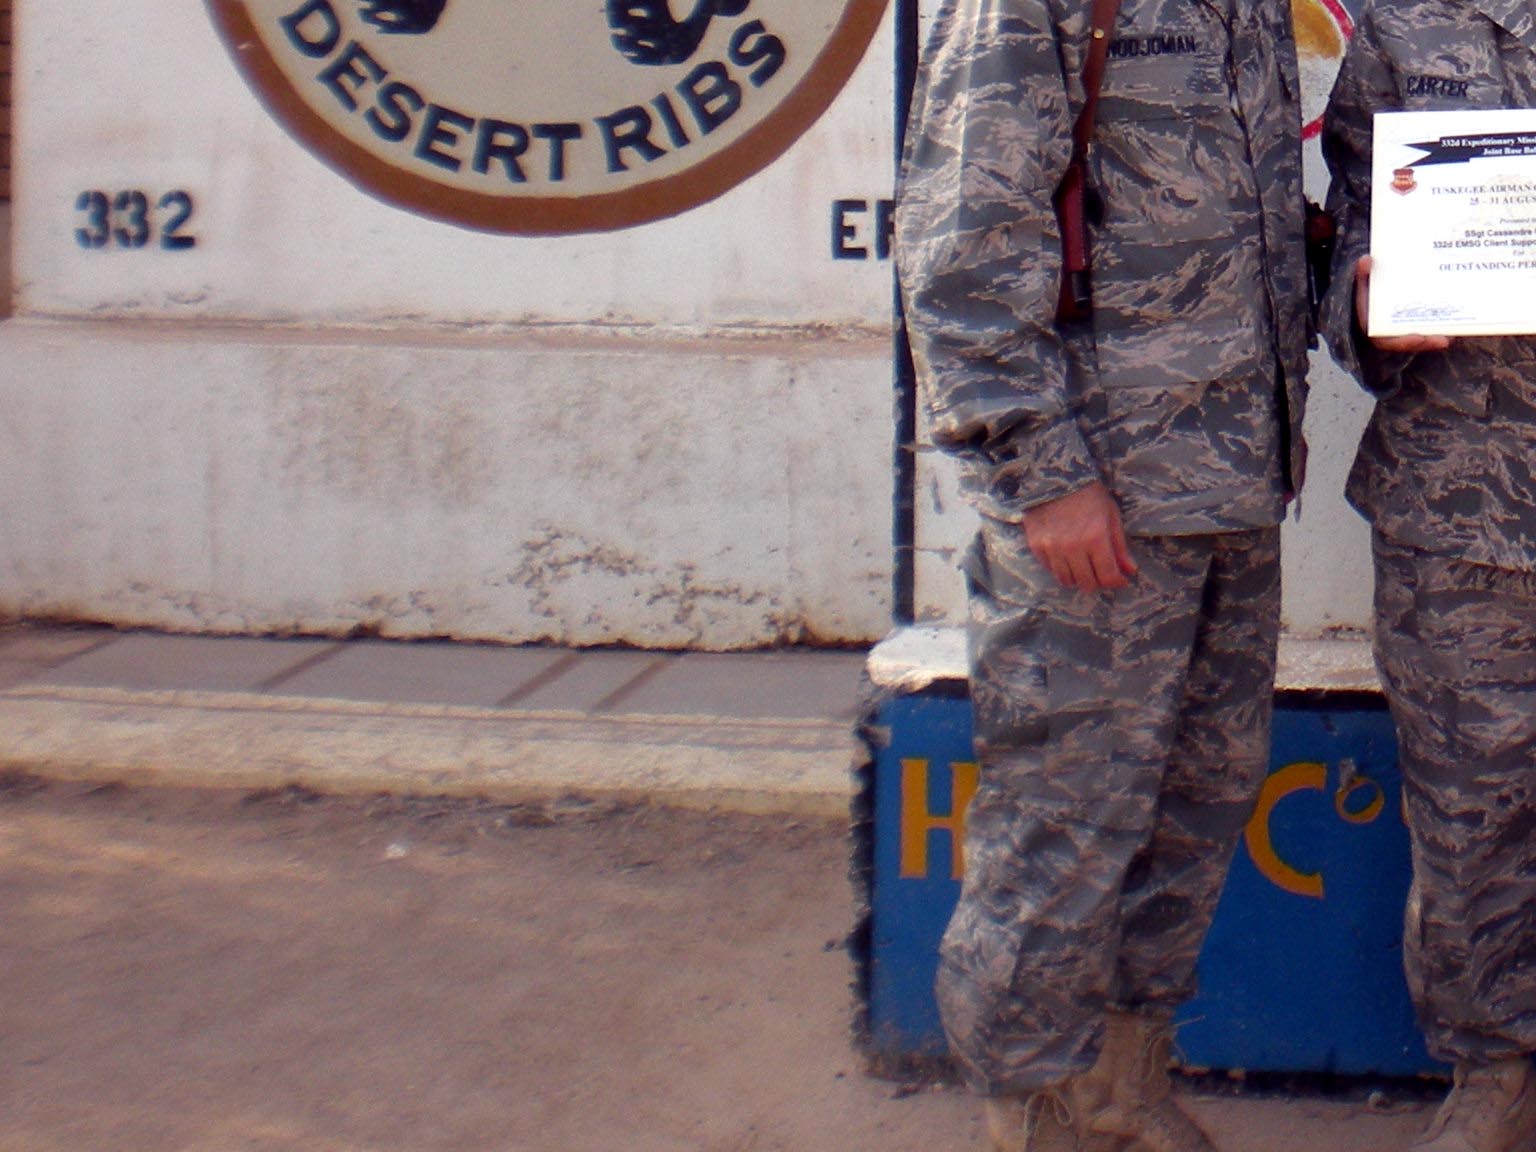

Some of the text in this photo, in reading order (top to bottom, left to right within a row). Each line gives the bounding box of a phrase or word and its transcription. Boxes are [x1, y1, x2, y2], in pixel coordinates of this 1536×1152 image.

[1406, 75, 1469, 98] CARTER
[592, 18, 788, 174] RIBS
[1462, 136, 1515, 149] Expeditionary
[1431, 184, 1489, 196] TUSKEGEE
[1490, 183, 1532, 194] AIRMAN
[71, 189, 198, 251] 332
[1464, 229, 1485, 239] SSgt
[1432, 240, 1453, 249] 332d
[1455, 239, 1482, 249] EMSG
[1484, 237, 1509, 248] Client
[1439, 261, 1516, 272] OUTSTANDING
